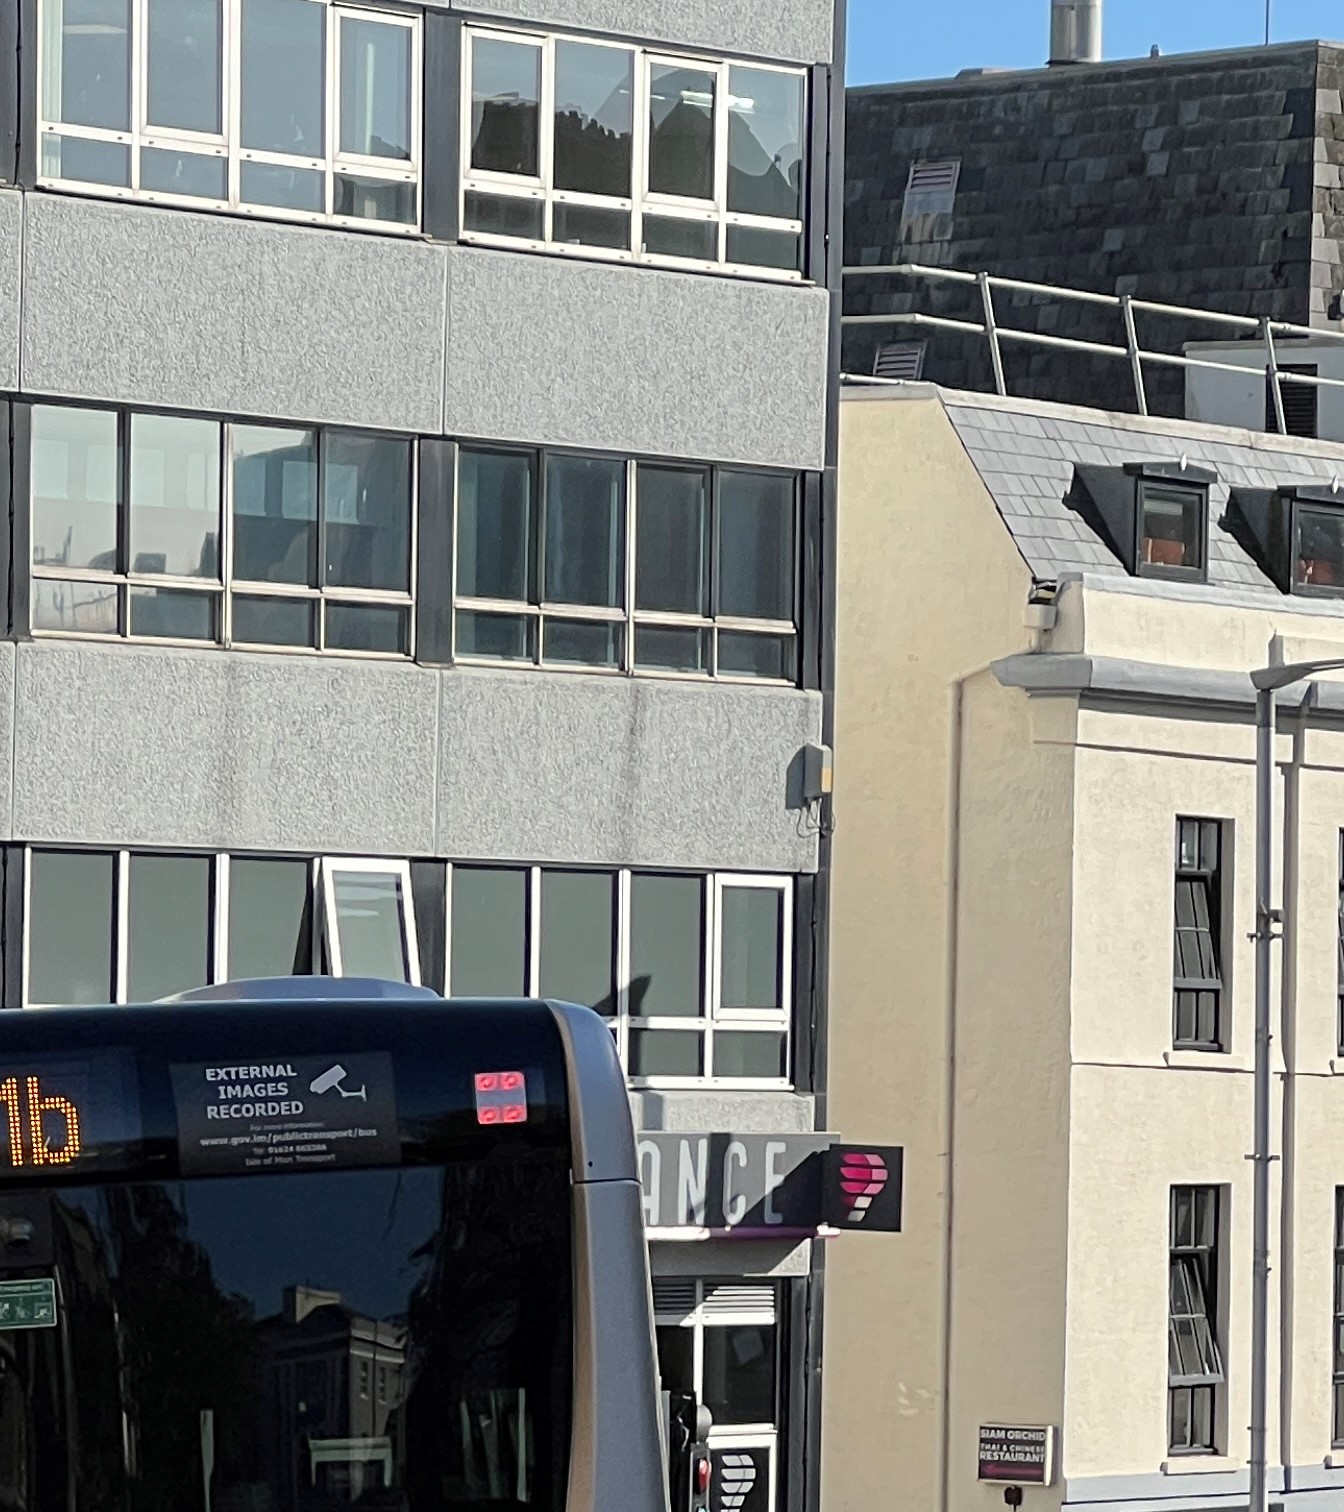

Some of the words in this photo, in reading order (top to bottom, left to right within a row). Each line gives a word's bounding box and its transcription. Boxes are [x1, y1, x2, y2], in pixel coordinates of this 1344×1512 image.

[206, 1064, 297, 1081] EXTERNAL
[218, 1082, 289, 1099] IMAGES
[207, 1101, 304, 1119] RECORDED
[980, 1429, 1005, 1439] SIAM
[1007, 1430, 1045, 1441] ORCHID
[980, 1451, 1045, 1462] RESTAURANT
